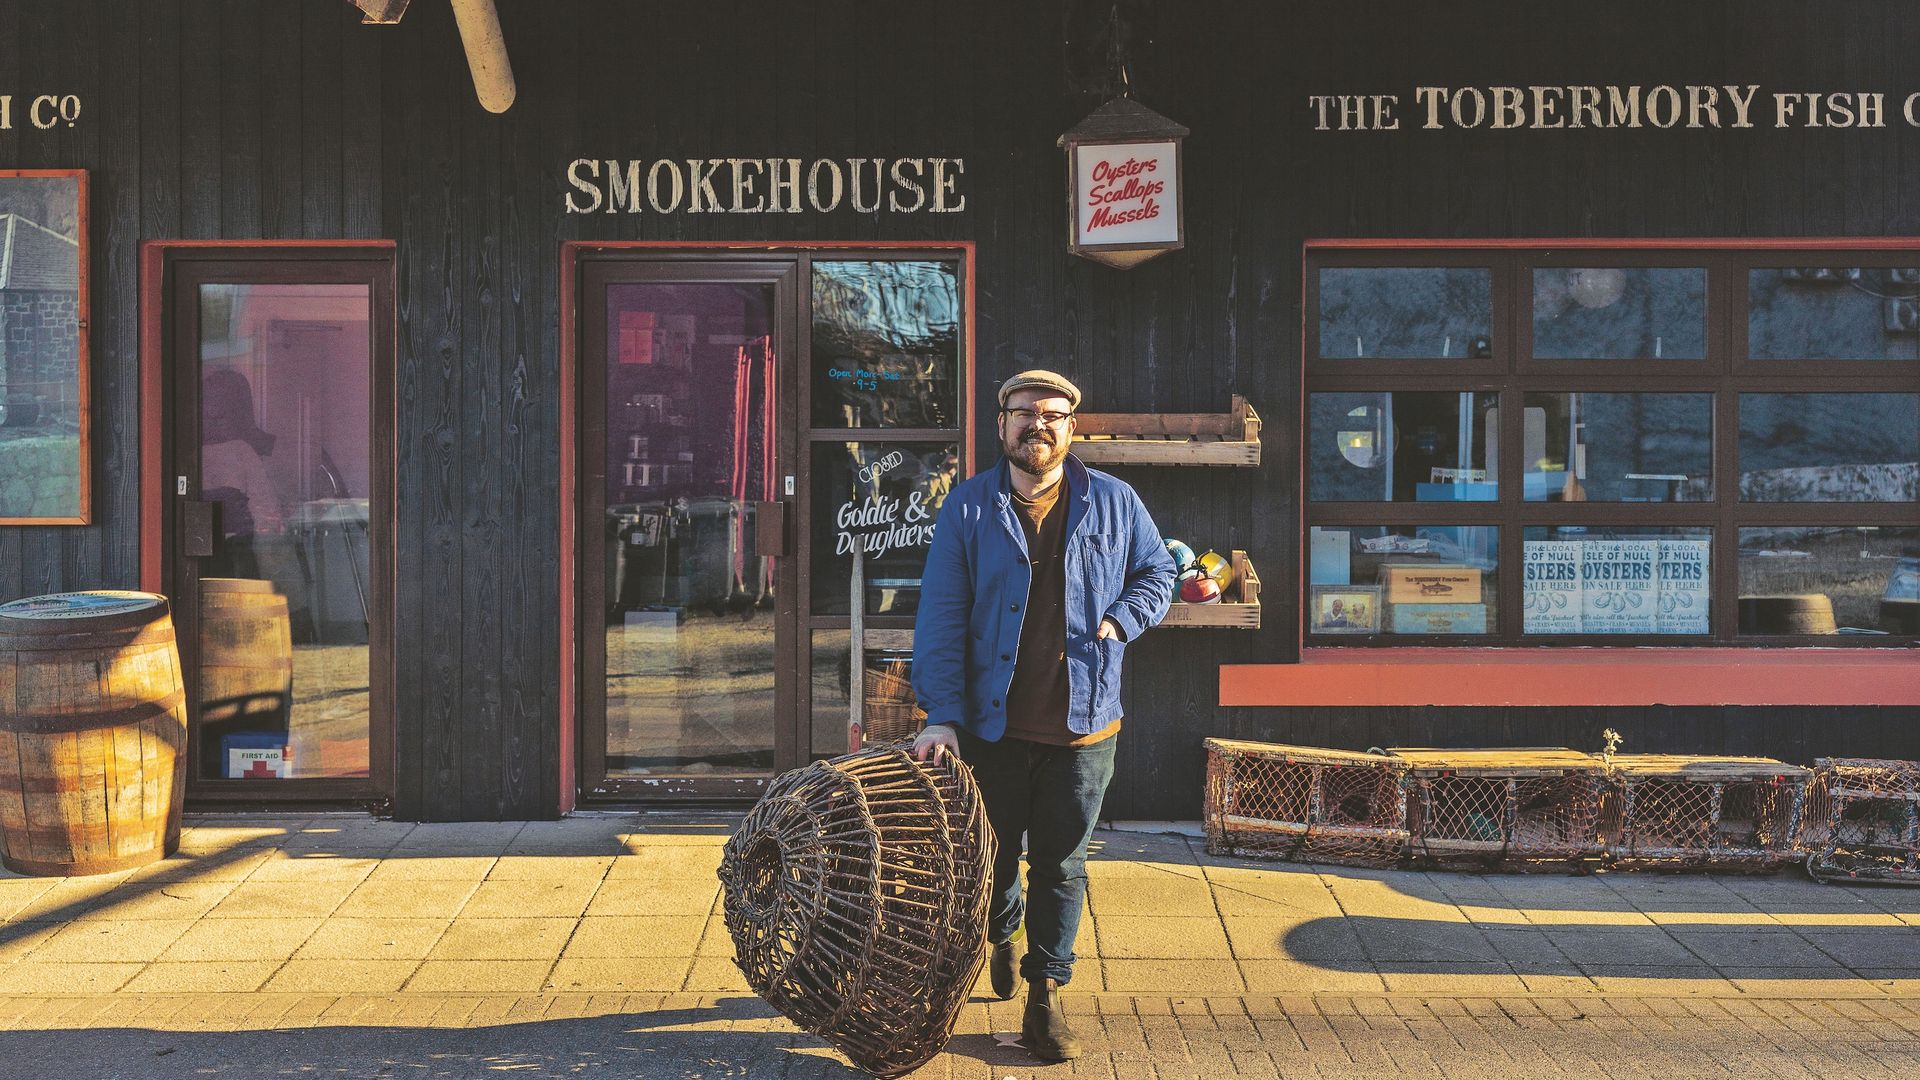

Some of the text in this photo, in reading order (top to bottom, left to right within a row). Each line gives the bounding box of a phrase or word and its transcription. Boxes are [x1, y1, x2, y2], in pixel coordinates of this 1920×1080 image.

[1308, 94, 1399, 131] THE
[1415, 84, 1761, 129] TOBERMORY
[1772, 92, 1887, 128] FISH
[1092, 158, 1158, 186] Oysters
[564, 157, 967, 215] SMOKEHOUSE
[1088, 178, 1164, 206] Scallops
[1087, 199, 1160, 232] Mussels
[828, 368, 852, 380] Open
[856, 379, 878, 391] 9-5
[859, 451, 903, 483] CLOSED
[837, 491, 931, 528] Goldie &
[836, 523, 936, 559] Dughters
[1531, 552, 1544, 560] OF
[1548, 552, 1574, 560] MULL
[1607, 552, 1620, 560] OF
[1624, 552, 1651, 560] MULL
[1674, 552, 1702, 560] MULL
[1525, 562, 1576, 580] STERS
[1583, 562, 1651, 580] OYSTERS
[1599, 581, 1622, 590] SALE
